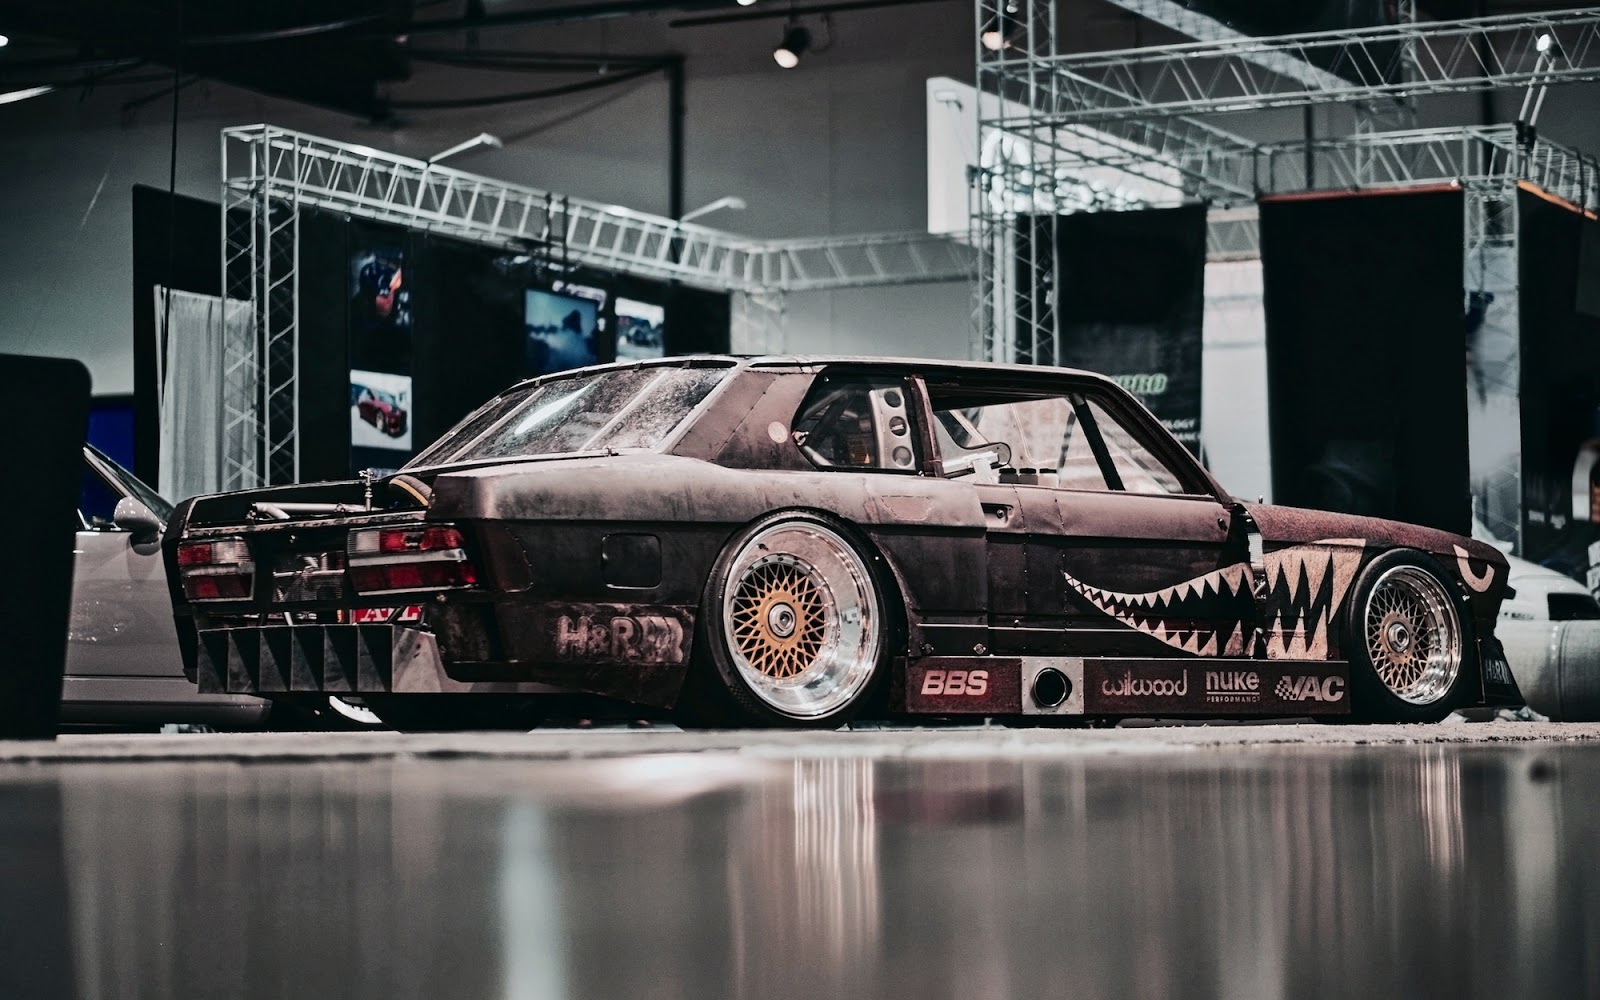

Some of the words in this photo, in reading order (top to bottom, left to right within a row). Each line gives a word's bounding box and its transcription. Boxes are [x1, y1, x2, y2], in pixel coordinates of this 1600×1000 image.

[921, 670, 988, 696] BBS
[1102, 669, 1188, 696] wilwood
[1205, 671, 1260, 690] nuke
[1280, 675, 1345, 702] VAC
